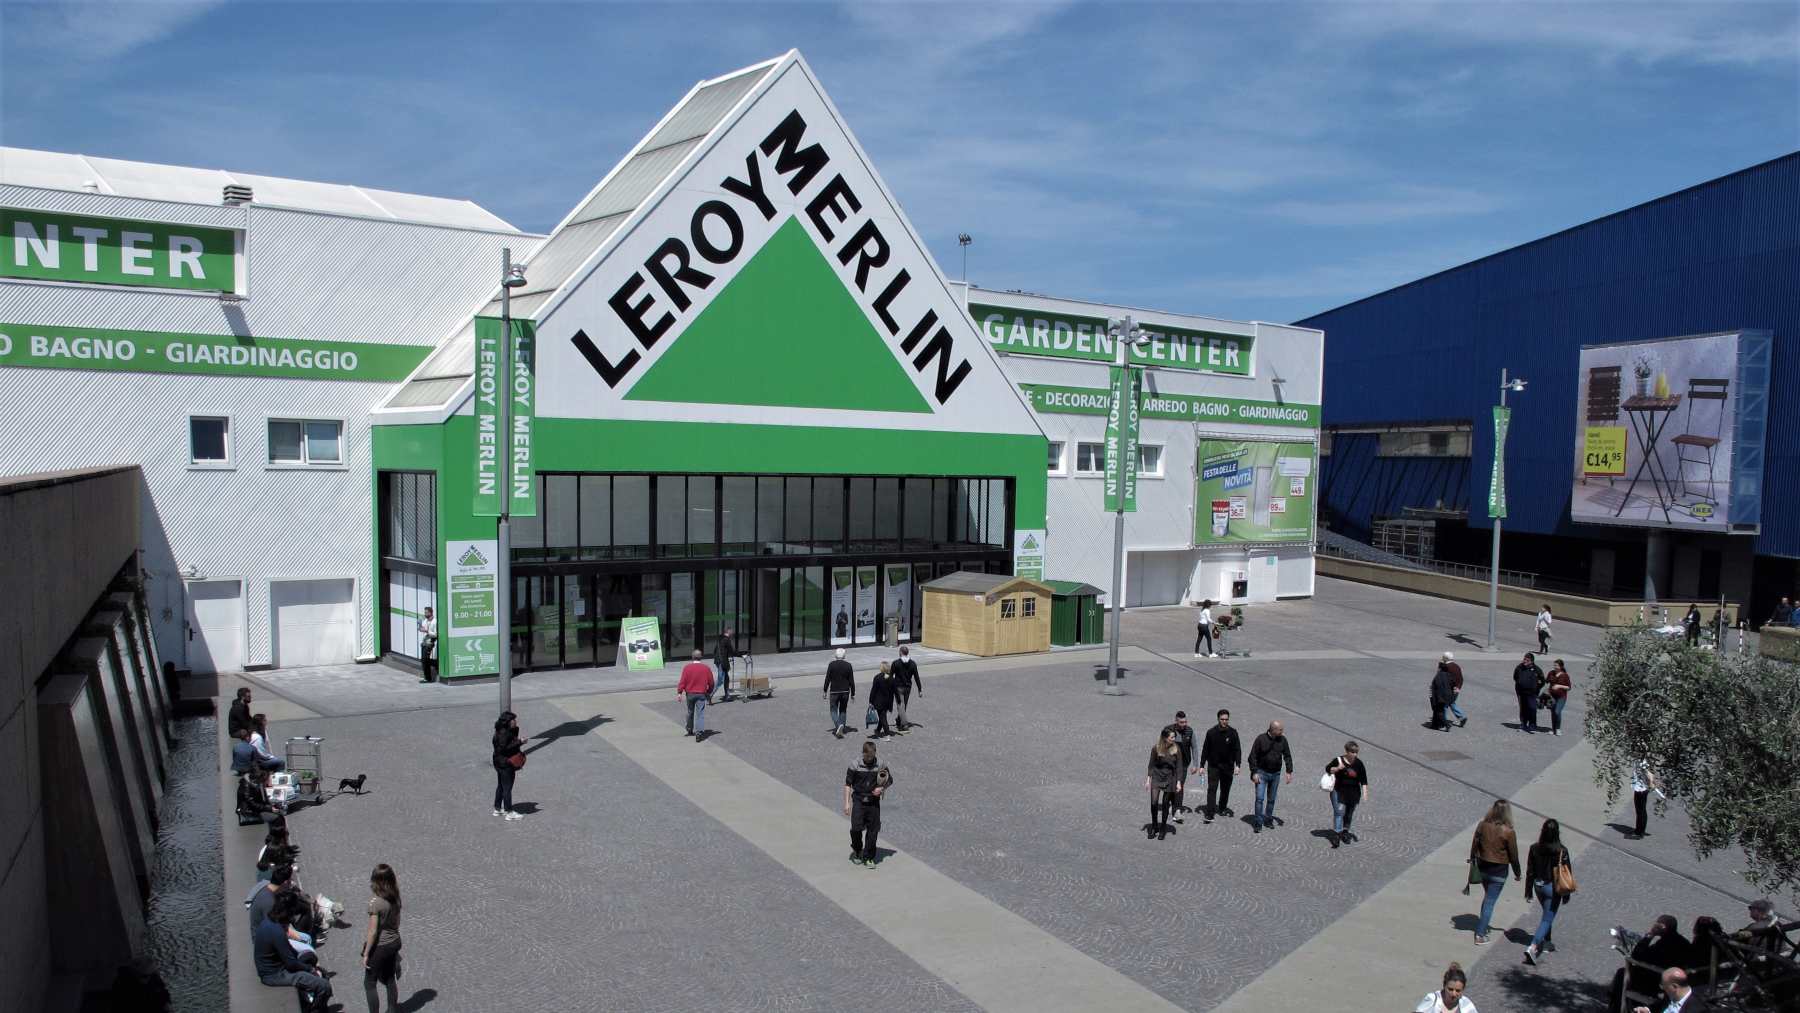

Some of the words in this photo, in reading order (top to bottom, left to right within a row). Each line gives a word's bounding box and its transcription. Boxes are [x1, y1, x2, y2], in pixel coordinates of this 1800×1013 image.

[14, 221, 206, 280] NTER
[571, 150, 778, 389] LEROY
[759, 109, 973, 406] MERLIN
[31, 336, 136, 361] BAGNO
[166, 342, 358, 371] GIARDINAGGIO
[983, 313, 1113, 354] GARDEN
[1131, 332, 1240, 368] CENTER
[480, 338, 496, 407] LEROY
[514, 337, 530, 408] LEROY
[1143, 398, 1188, 413] ARREDO
[1192, 402, 1230, 416] BAGNO
[1239, 405, 1308, 421] GIARDINAGGIO
[479, 415, 496, 495] MERLIN
[514, 416, 529, 498] MERLIN
[1107, 437, 1119, 496] MERLIN
[1125, 438, 1136, 499] MERLIN
[1203, 467, 1219, 480] FESTA
[1219, 463, 1237, 475] DELLE
[1224, 468, 1252, 489] NOVITÀ
